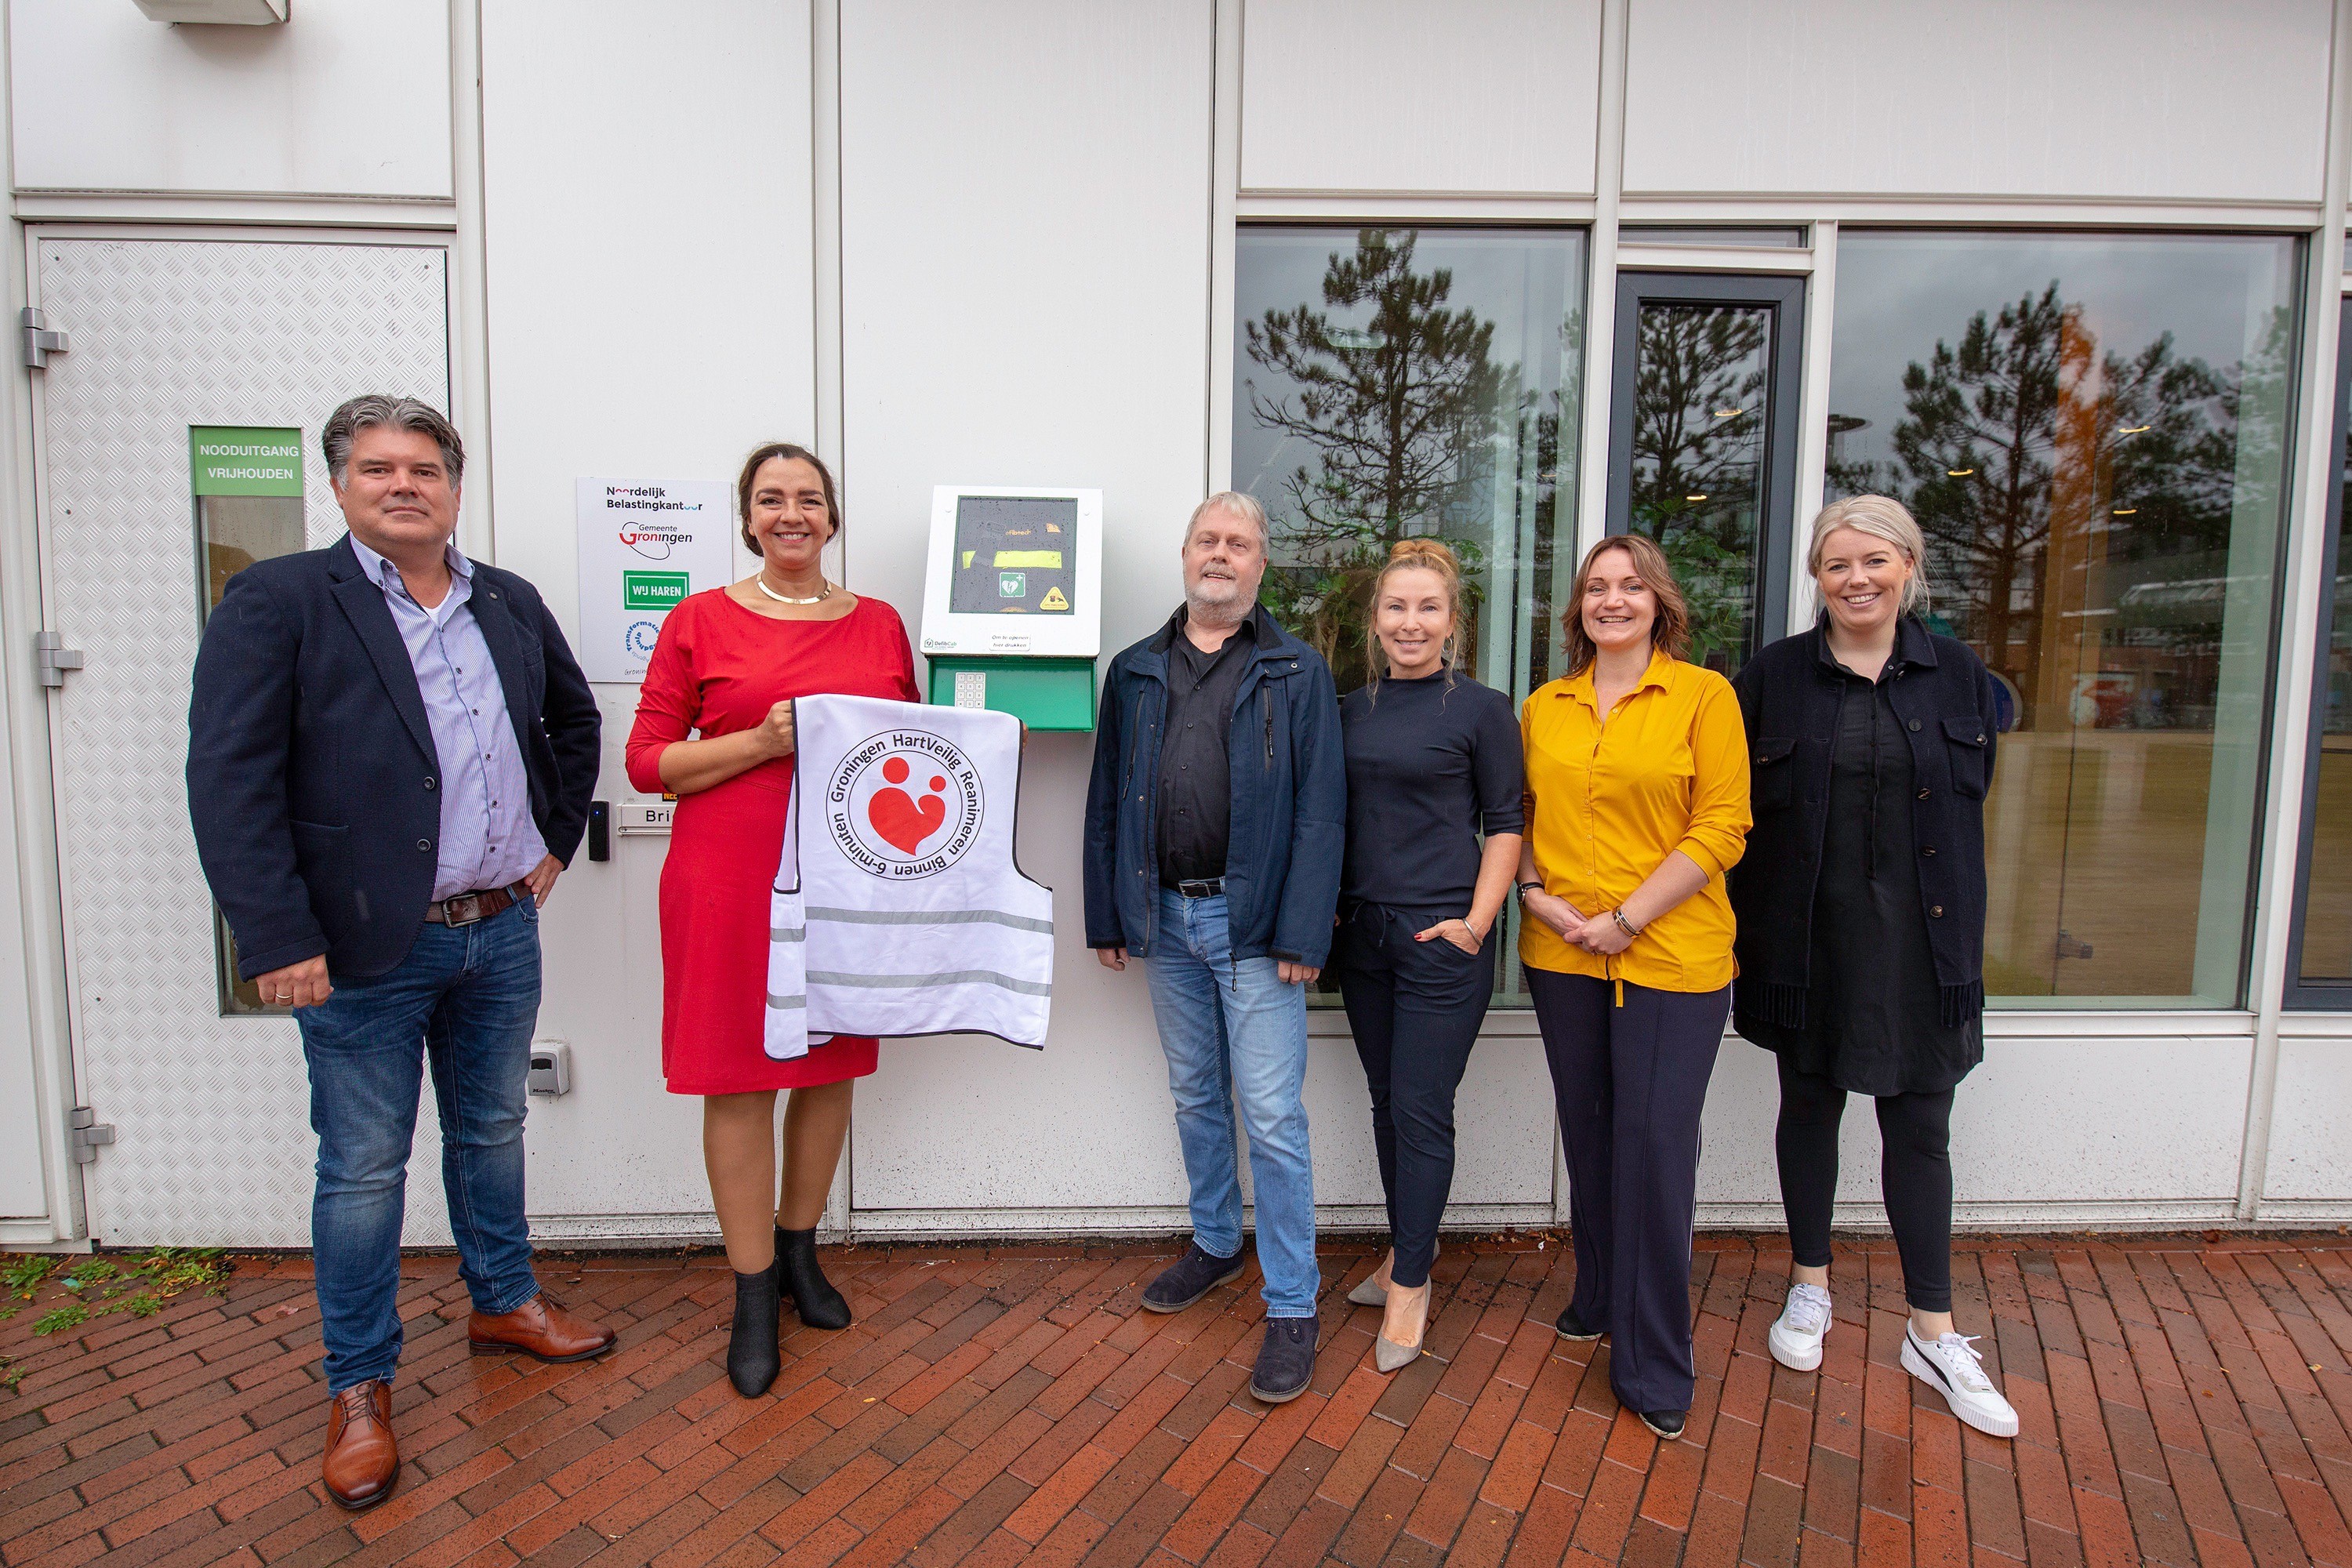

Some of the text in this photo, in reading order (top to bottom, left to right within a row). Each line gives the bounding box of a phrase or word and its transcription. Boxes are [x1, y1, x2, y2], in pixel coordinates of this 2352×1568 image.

[200, 445, 299, 457] NOODUITGANG
[208, 467, 293, 480] VRIJHOUDEN
[619, 532, 692, 545] Groningen
[652, 586, 681, 597] HAREN
[626, 621, 659, 652] Transformatie
[635, 632, 655, 651] gdhulp
[831, 734, 980, 875] Groningen HartVeilig Reanimeren Binnen 6-minuten
[646, 810, 670, 822] Bri
